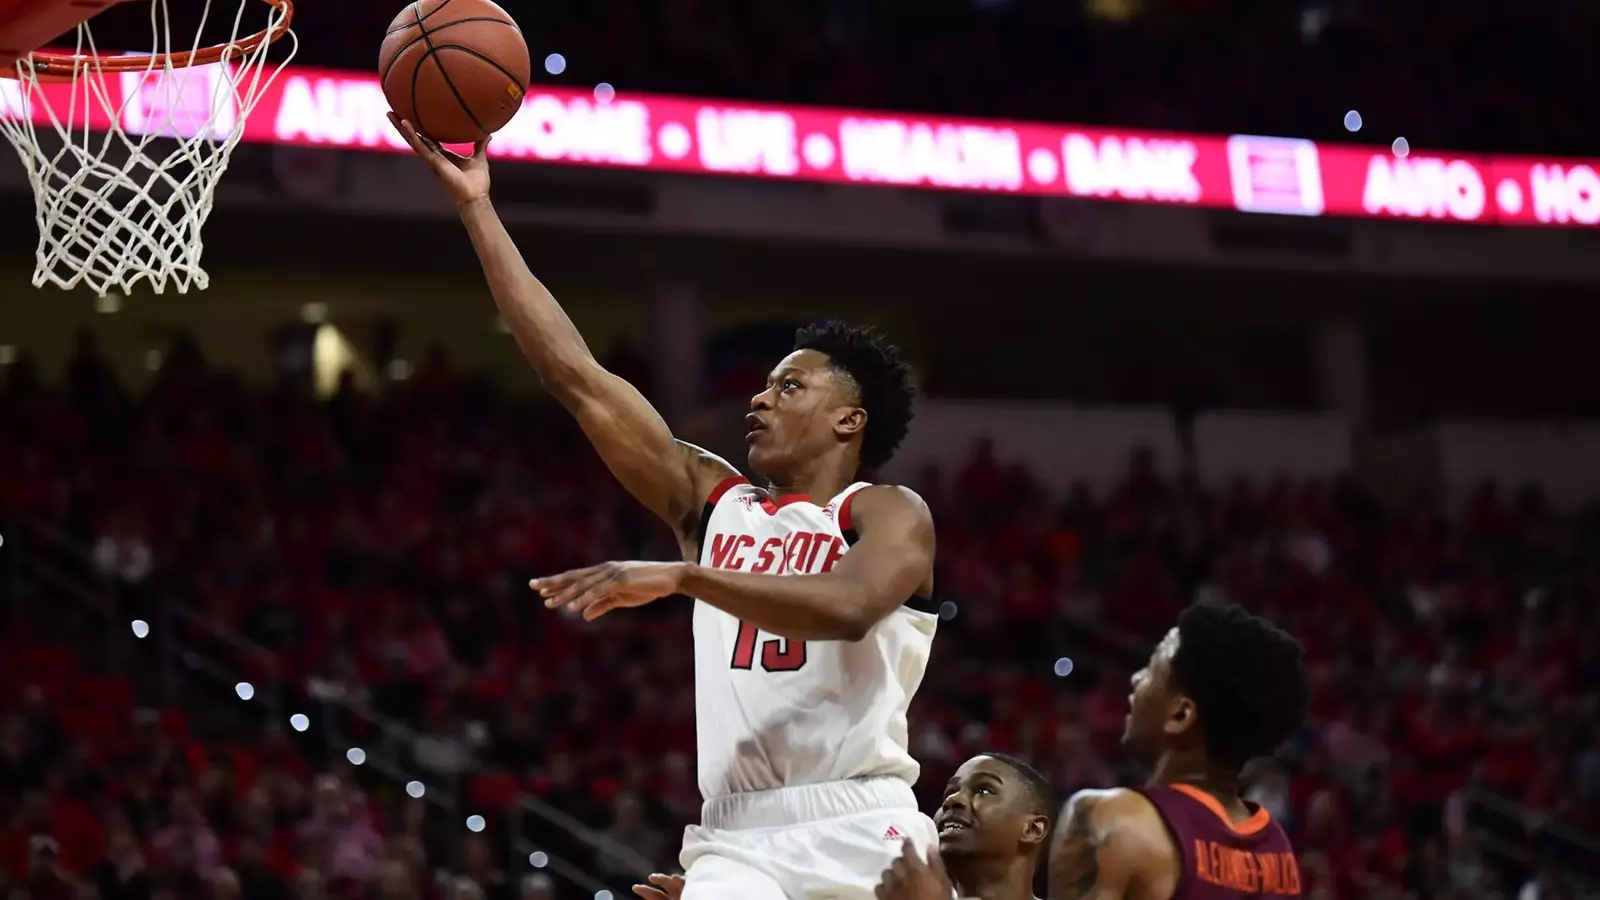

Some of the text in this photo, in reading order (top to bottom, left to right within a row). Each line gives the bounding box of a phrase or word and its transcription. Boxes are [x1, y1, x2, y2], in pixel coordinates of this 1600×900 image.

[274, 75, 414, 149] AUT
[695, 106, 799, 176] LIFE
[838, 117, 1023, 191] HEALTH
[1060, 132, 1203, 203] BANK
[1363, 154, 1486, 220] AUTO
[710, 533, 756, 571] NC
